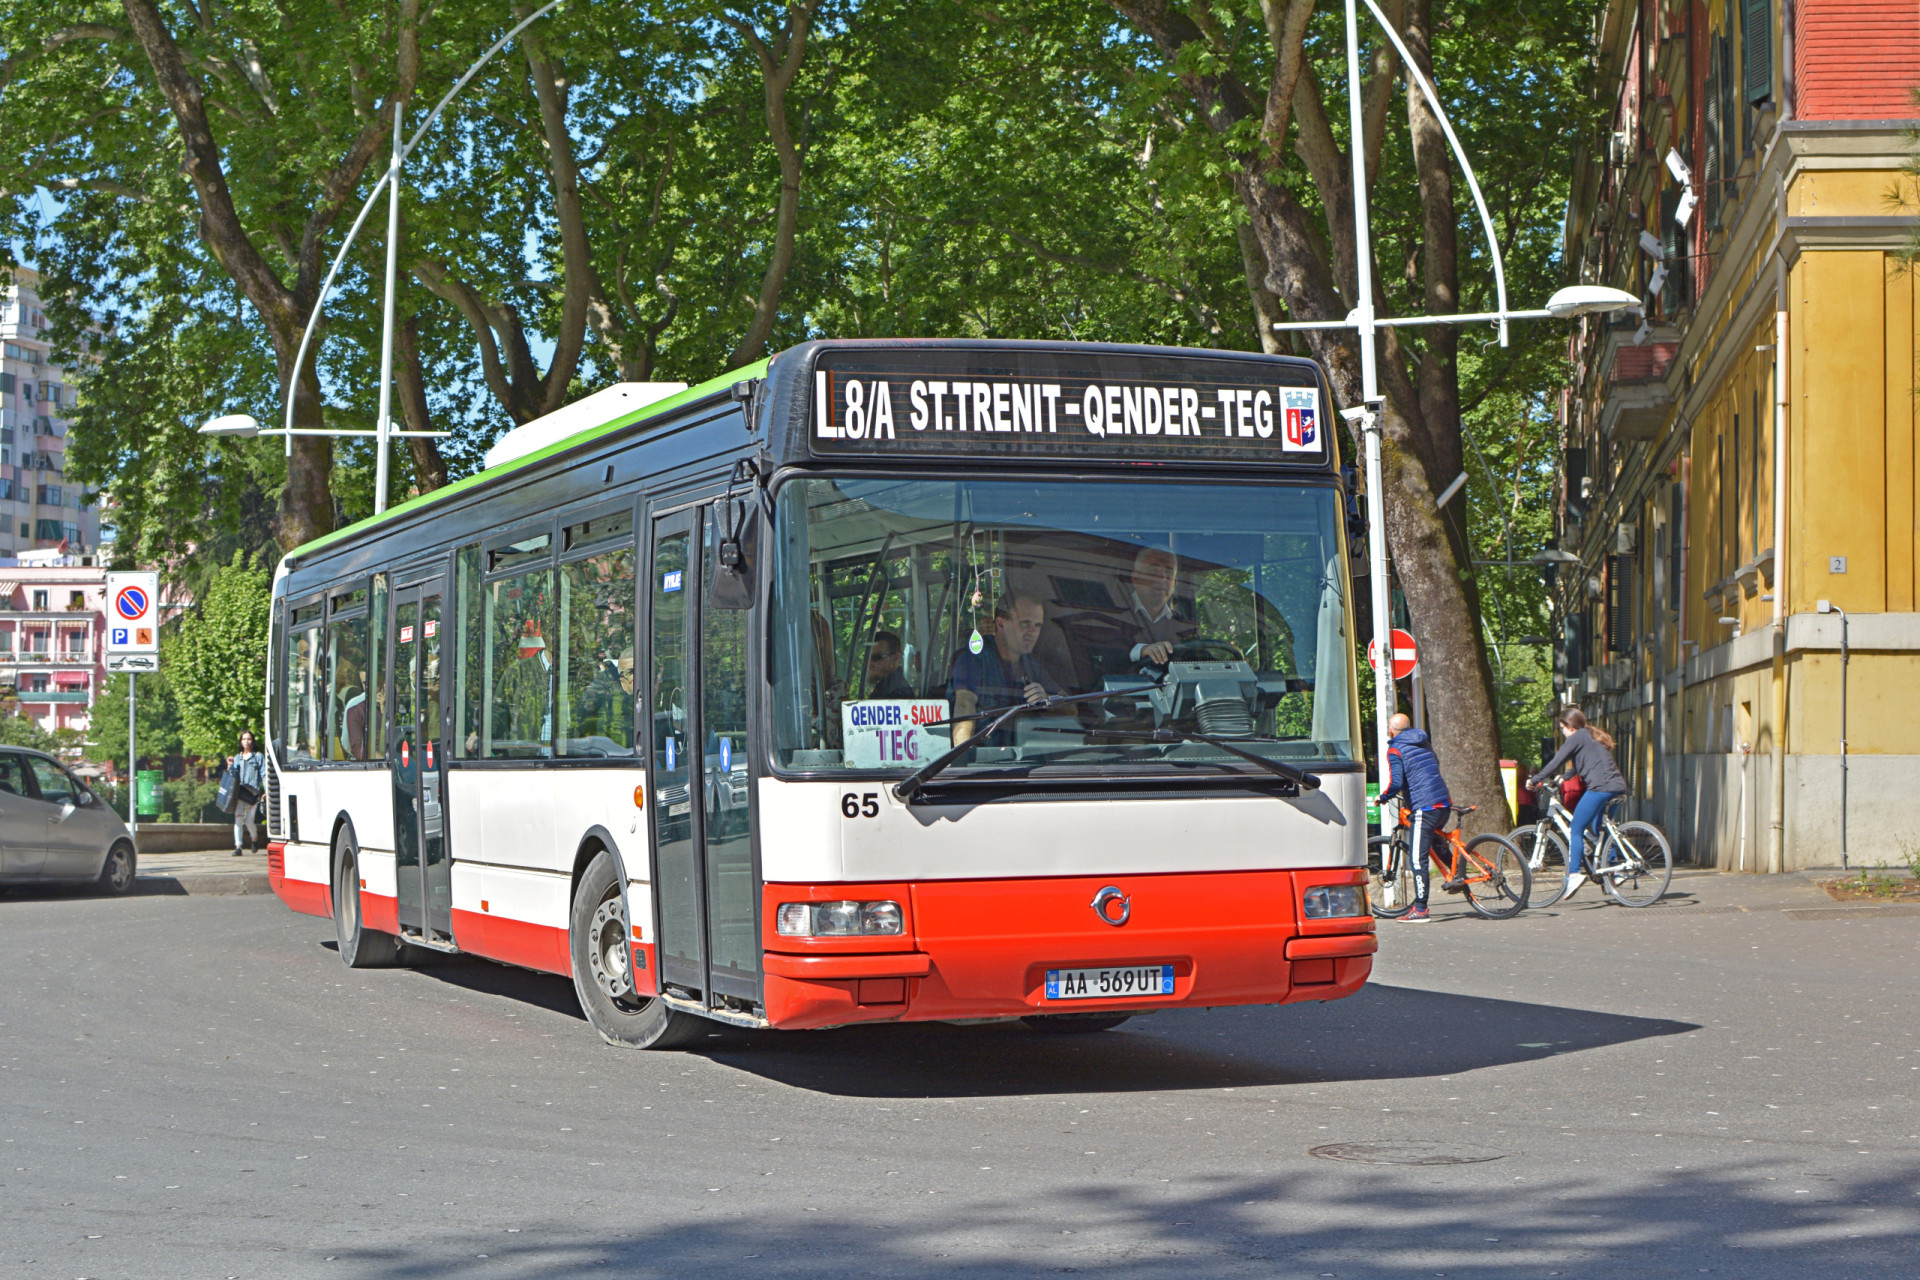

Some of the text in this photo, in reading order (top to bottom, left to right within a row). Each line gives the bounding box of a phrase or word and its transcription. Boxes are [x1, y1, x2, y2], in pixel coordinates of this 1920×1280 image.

[816, 371, 895, 440] L.8/A
[1834, 559, 1841, 570] 2
[115, 629, 126, 644] P
[851, 705, 902, 727] QENDER
[911, 705, 943, 726] SAUK
[876, 729, 919, 761] TEG
[841, 792, 880, 819] 65
[1047, 987, 1058, 995] AL
[1064, 968, 1160, 995] AA 569UT
